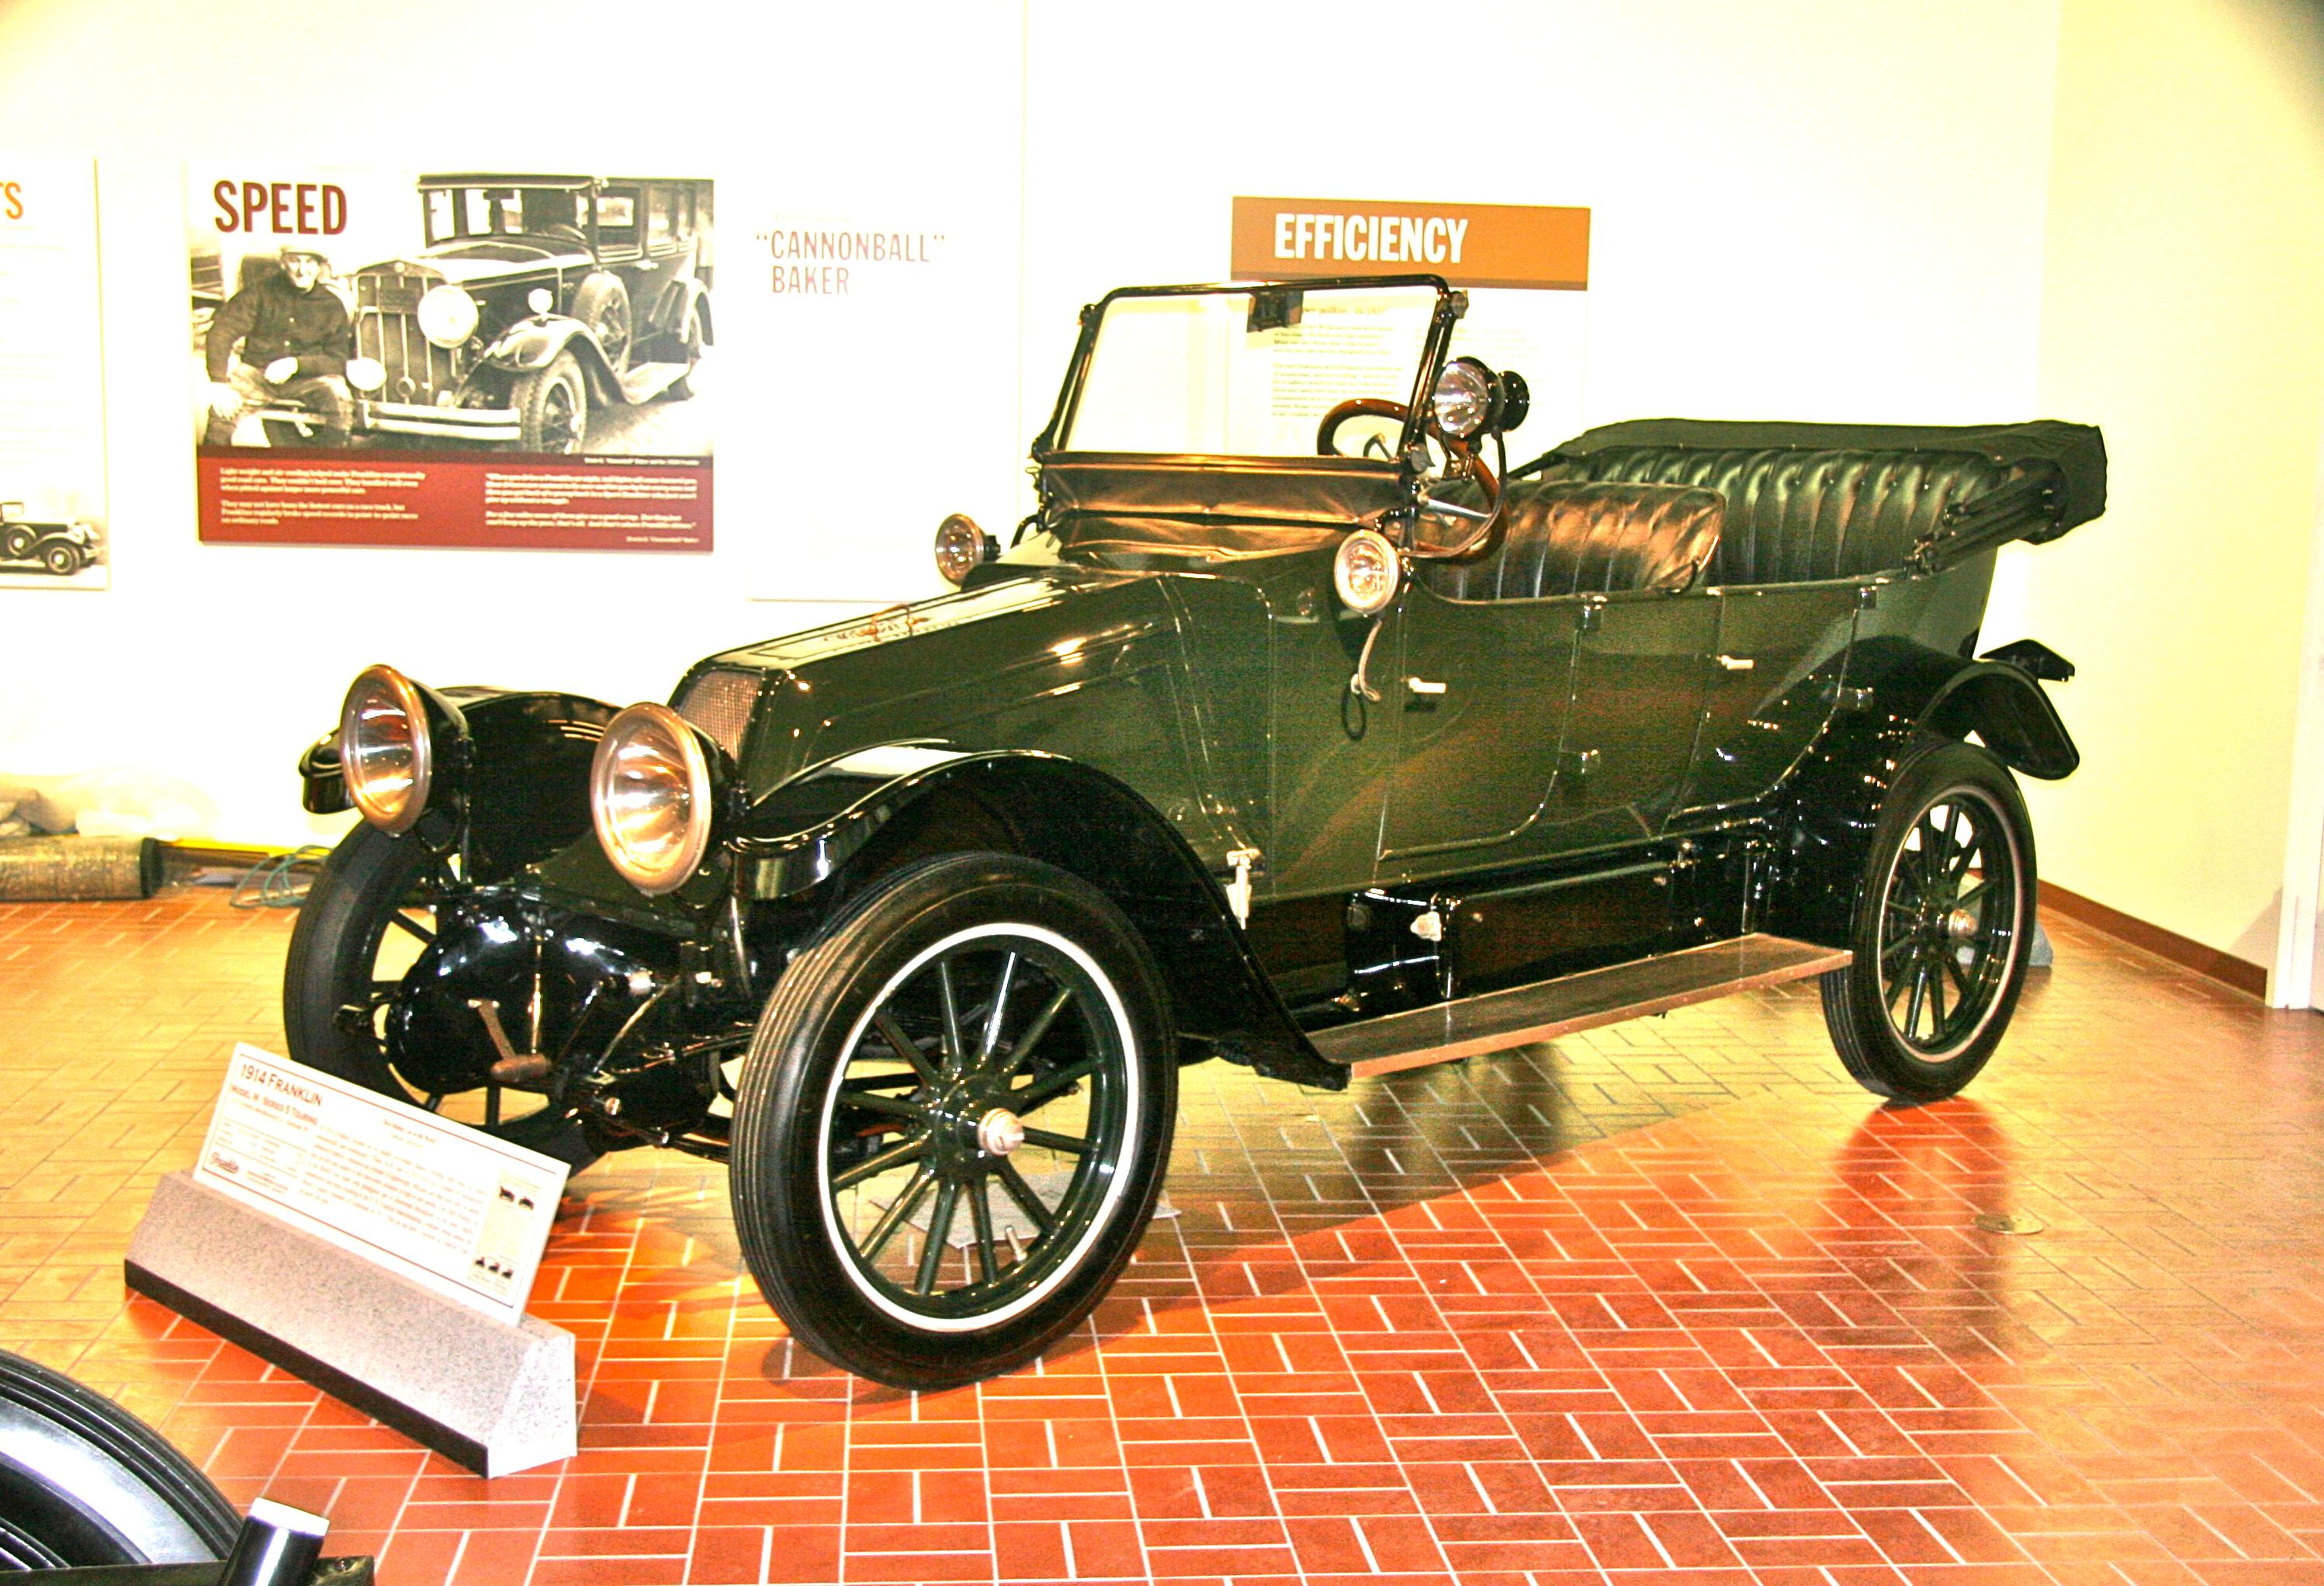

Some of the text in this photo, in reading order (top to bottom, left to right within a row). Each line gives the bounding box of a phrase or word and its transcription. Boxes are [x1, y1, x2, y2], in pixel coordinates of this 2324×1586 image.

[0, 182, 24, 220] S
[213, 180, 348, 235] SPEED
[1274, 213, 1469, 264] EFFICIENCY
[772, 265, 850, 295] BAKER
[240, 1063, 268, 1085] 1914
